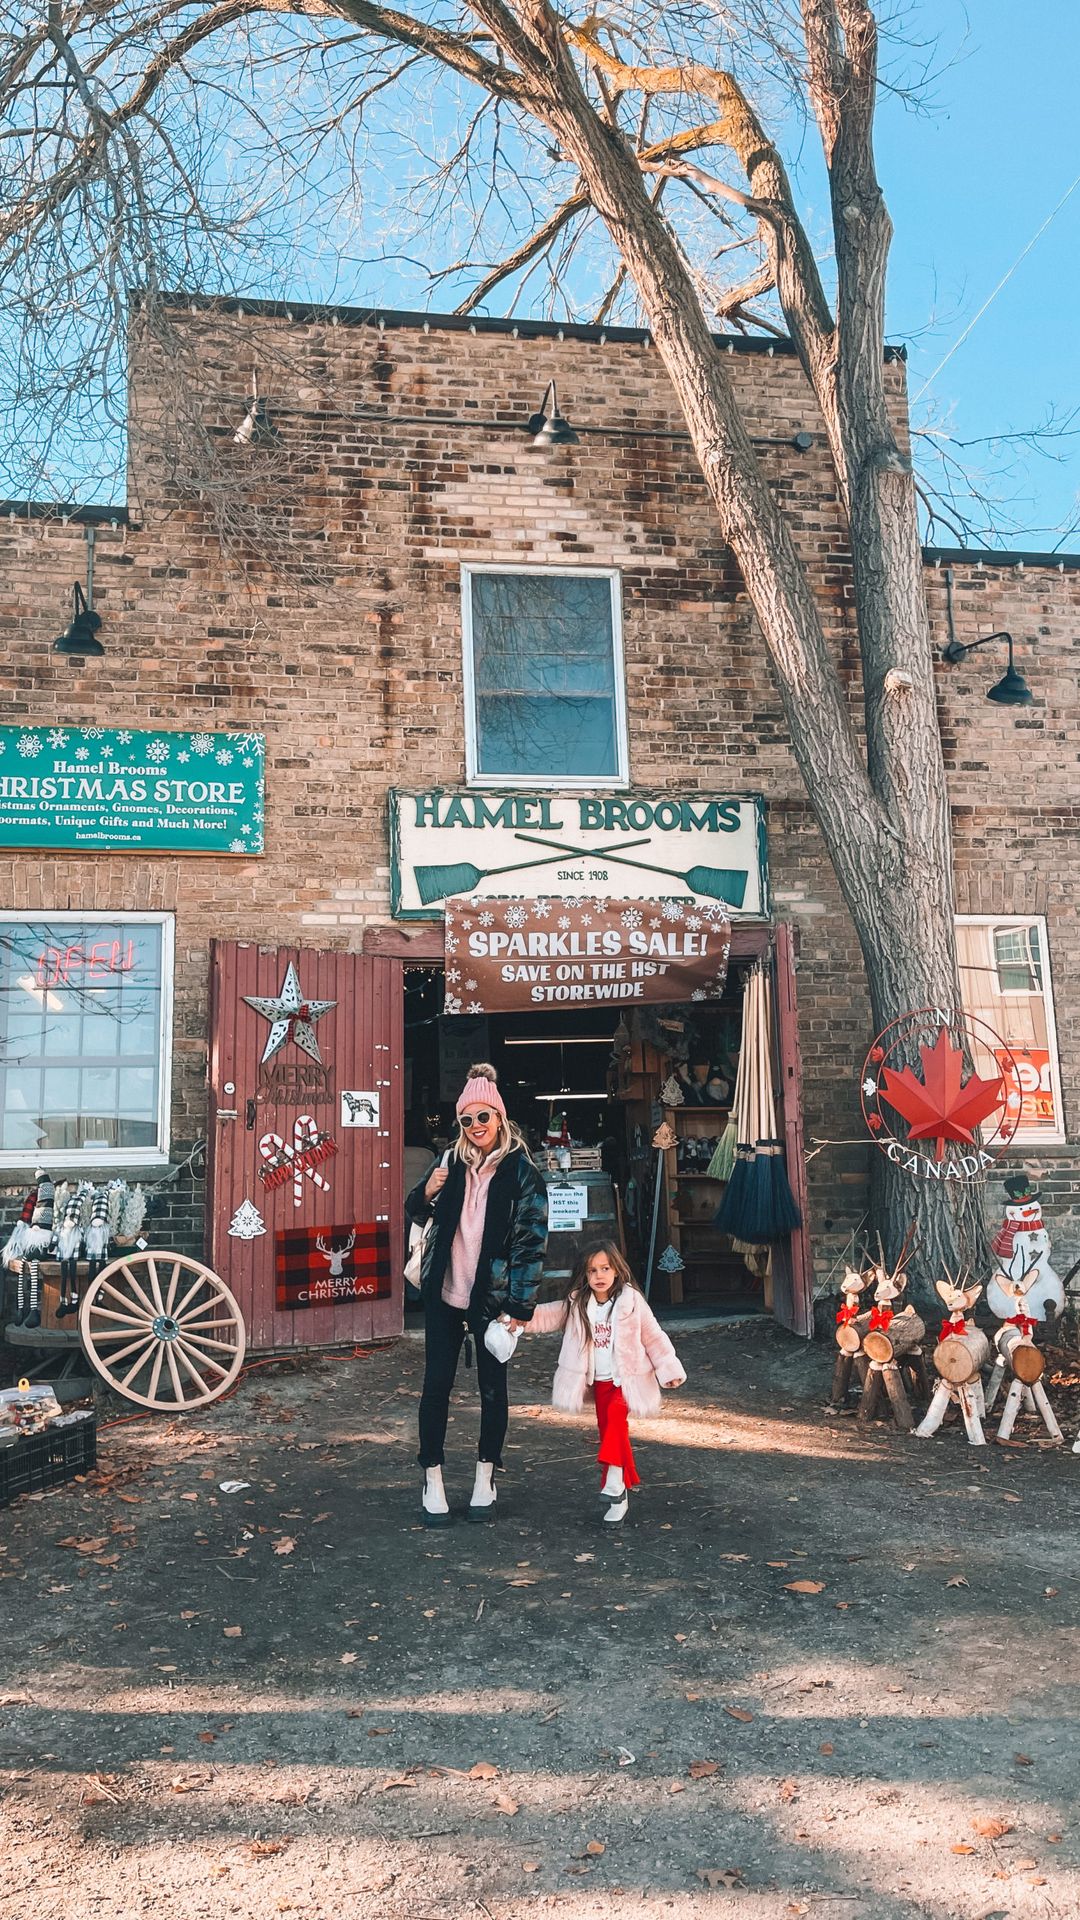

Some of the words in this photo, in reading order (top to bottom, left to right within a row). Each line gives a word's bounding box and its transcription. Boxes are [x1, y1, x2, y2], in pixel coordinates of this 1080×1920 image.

[53, 760, 104, 774] Hamel
[108, 761, 168, 776] Brooms
[153, 779, 246, 805] STORE
[0, 800, 36, 810] stmas
[39, 801, 109, 812] Ornaments,
[112, 802, 163, 814] Gnomes,
[166, 804, 238, 816] Decorations,
[414, 796, 564, 830] HAMEL
[579, 799, 742, 832] BROOMS
[55, 815, 97, 828] Unique
[99, 815, 129, 827] Gifts
[131, 818, 154, 828] and
[157, 818, 190, 829] Much
[193, 819, 227, 829] More!
[75, 831, 142, 841] hamelbrooms.ca
[557, 870, 585, 881] SINCE
[589, 870, 609, 881] 1908
[468, 929, 622, 959] SPARKLES
[628, 931, 708, 958] SALE!
[37, 940, 134, 986] OPEN
[501, 963, 552, 983] SAVE
[556, 964, 585, 981] ON
[590, 962, 626, 980] THE
[631, 962, 671, 979] HST
[531, 981, 645, 1003] STOREWIDE
[258, 1063, 335, 1089] MERRY
[887, 1142, 997, 1180] CANADA
[297, 1284, 375, 1301] CHRISTMAS
[315, 1276, 358, 1289] MERRY
